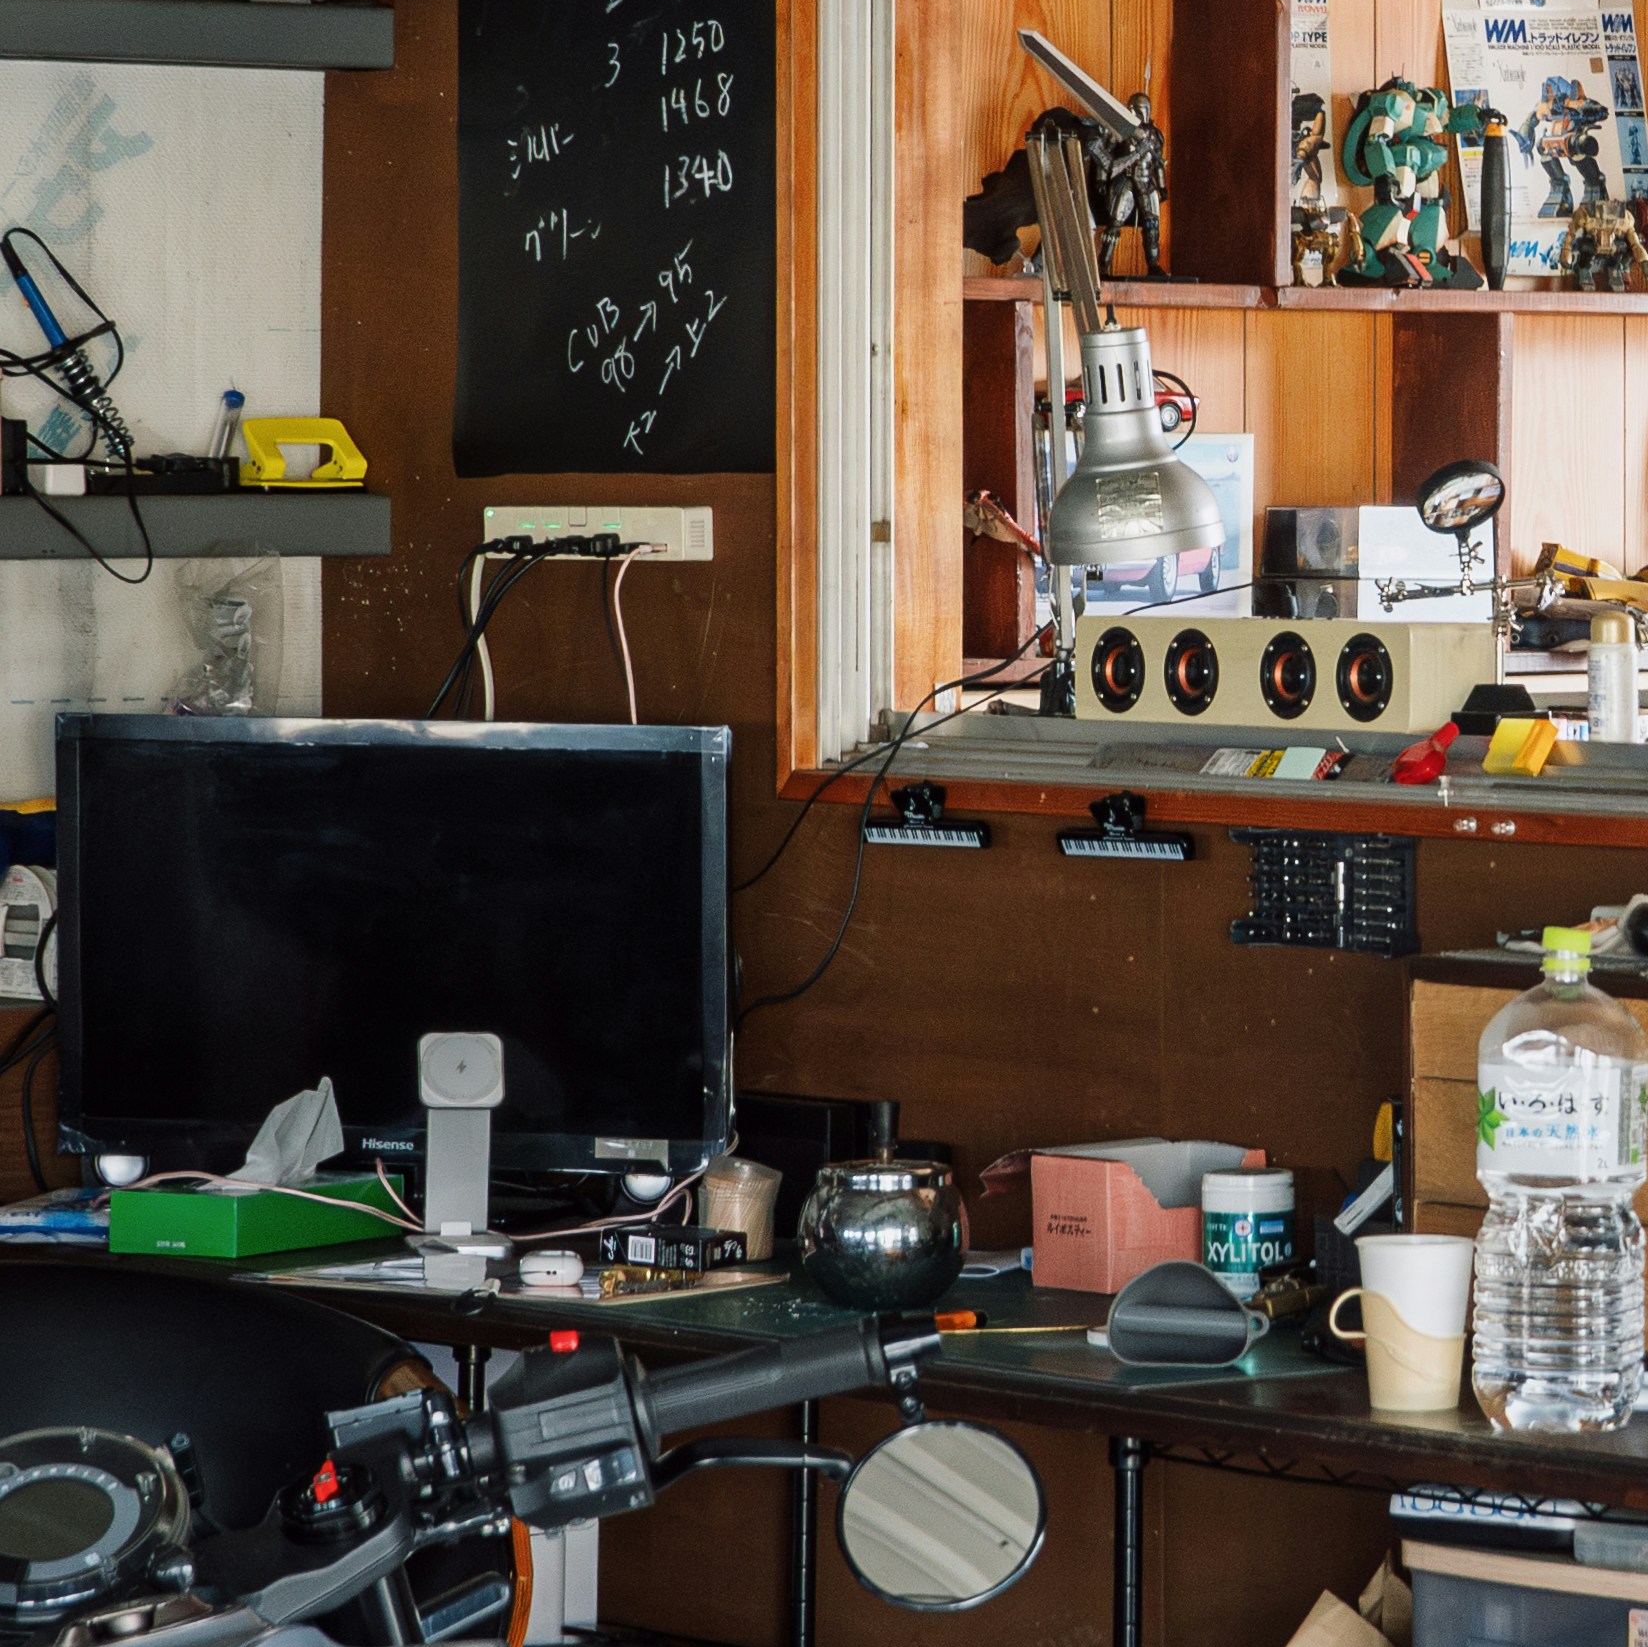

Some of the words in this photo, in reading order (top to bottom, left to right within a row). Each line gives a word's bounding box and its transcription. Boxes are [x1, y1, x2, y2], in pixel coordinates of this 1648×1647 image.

[1302, 32, 1327, 43] TYPE
[1485, 19, 1526, 44] WM
[1530, 33, 1600, 44] トラッドイレブン
[605, 43, 620, 87] 3
[661, 21, 724, 76] 1250
[661, 72, 734, 133] 1468
[664, 148, 733, 209] 1340
[362, 1137, 414, 1151] Hisense
[1506, 1124, 1599, 1140] 日本の天然水
[1208, 1240, 1284, 1264] XYLITOL
